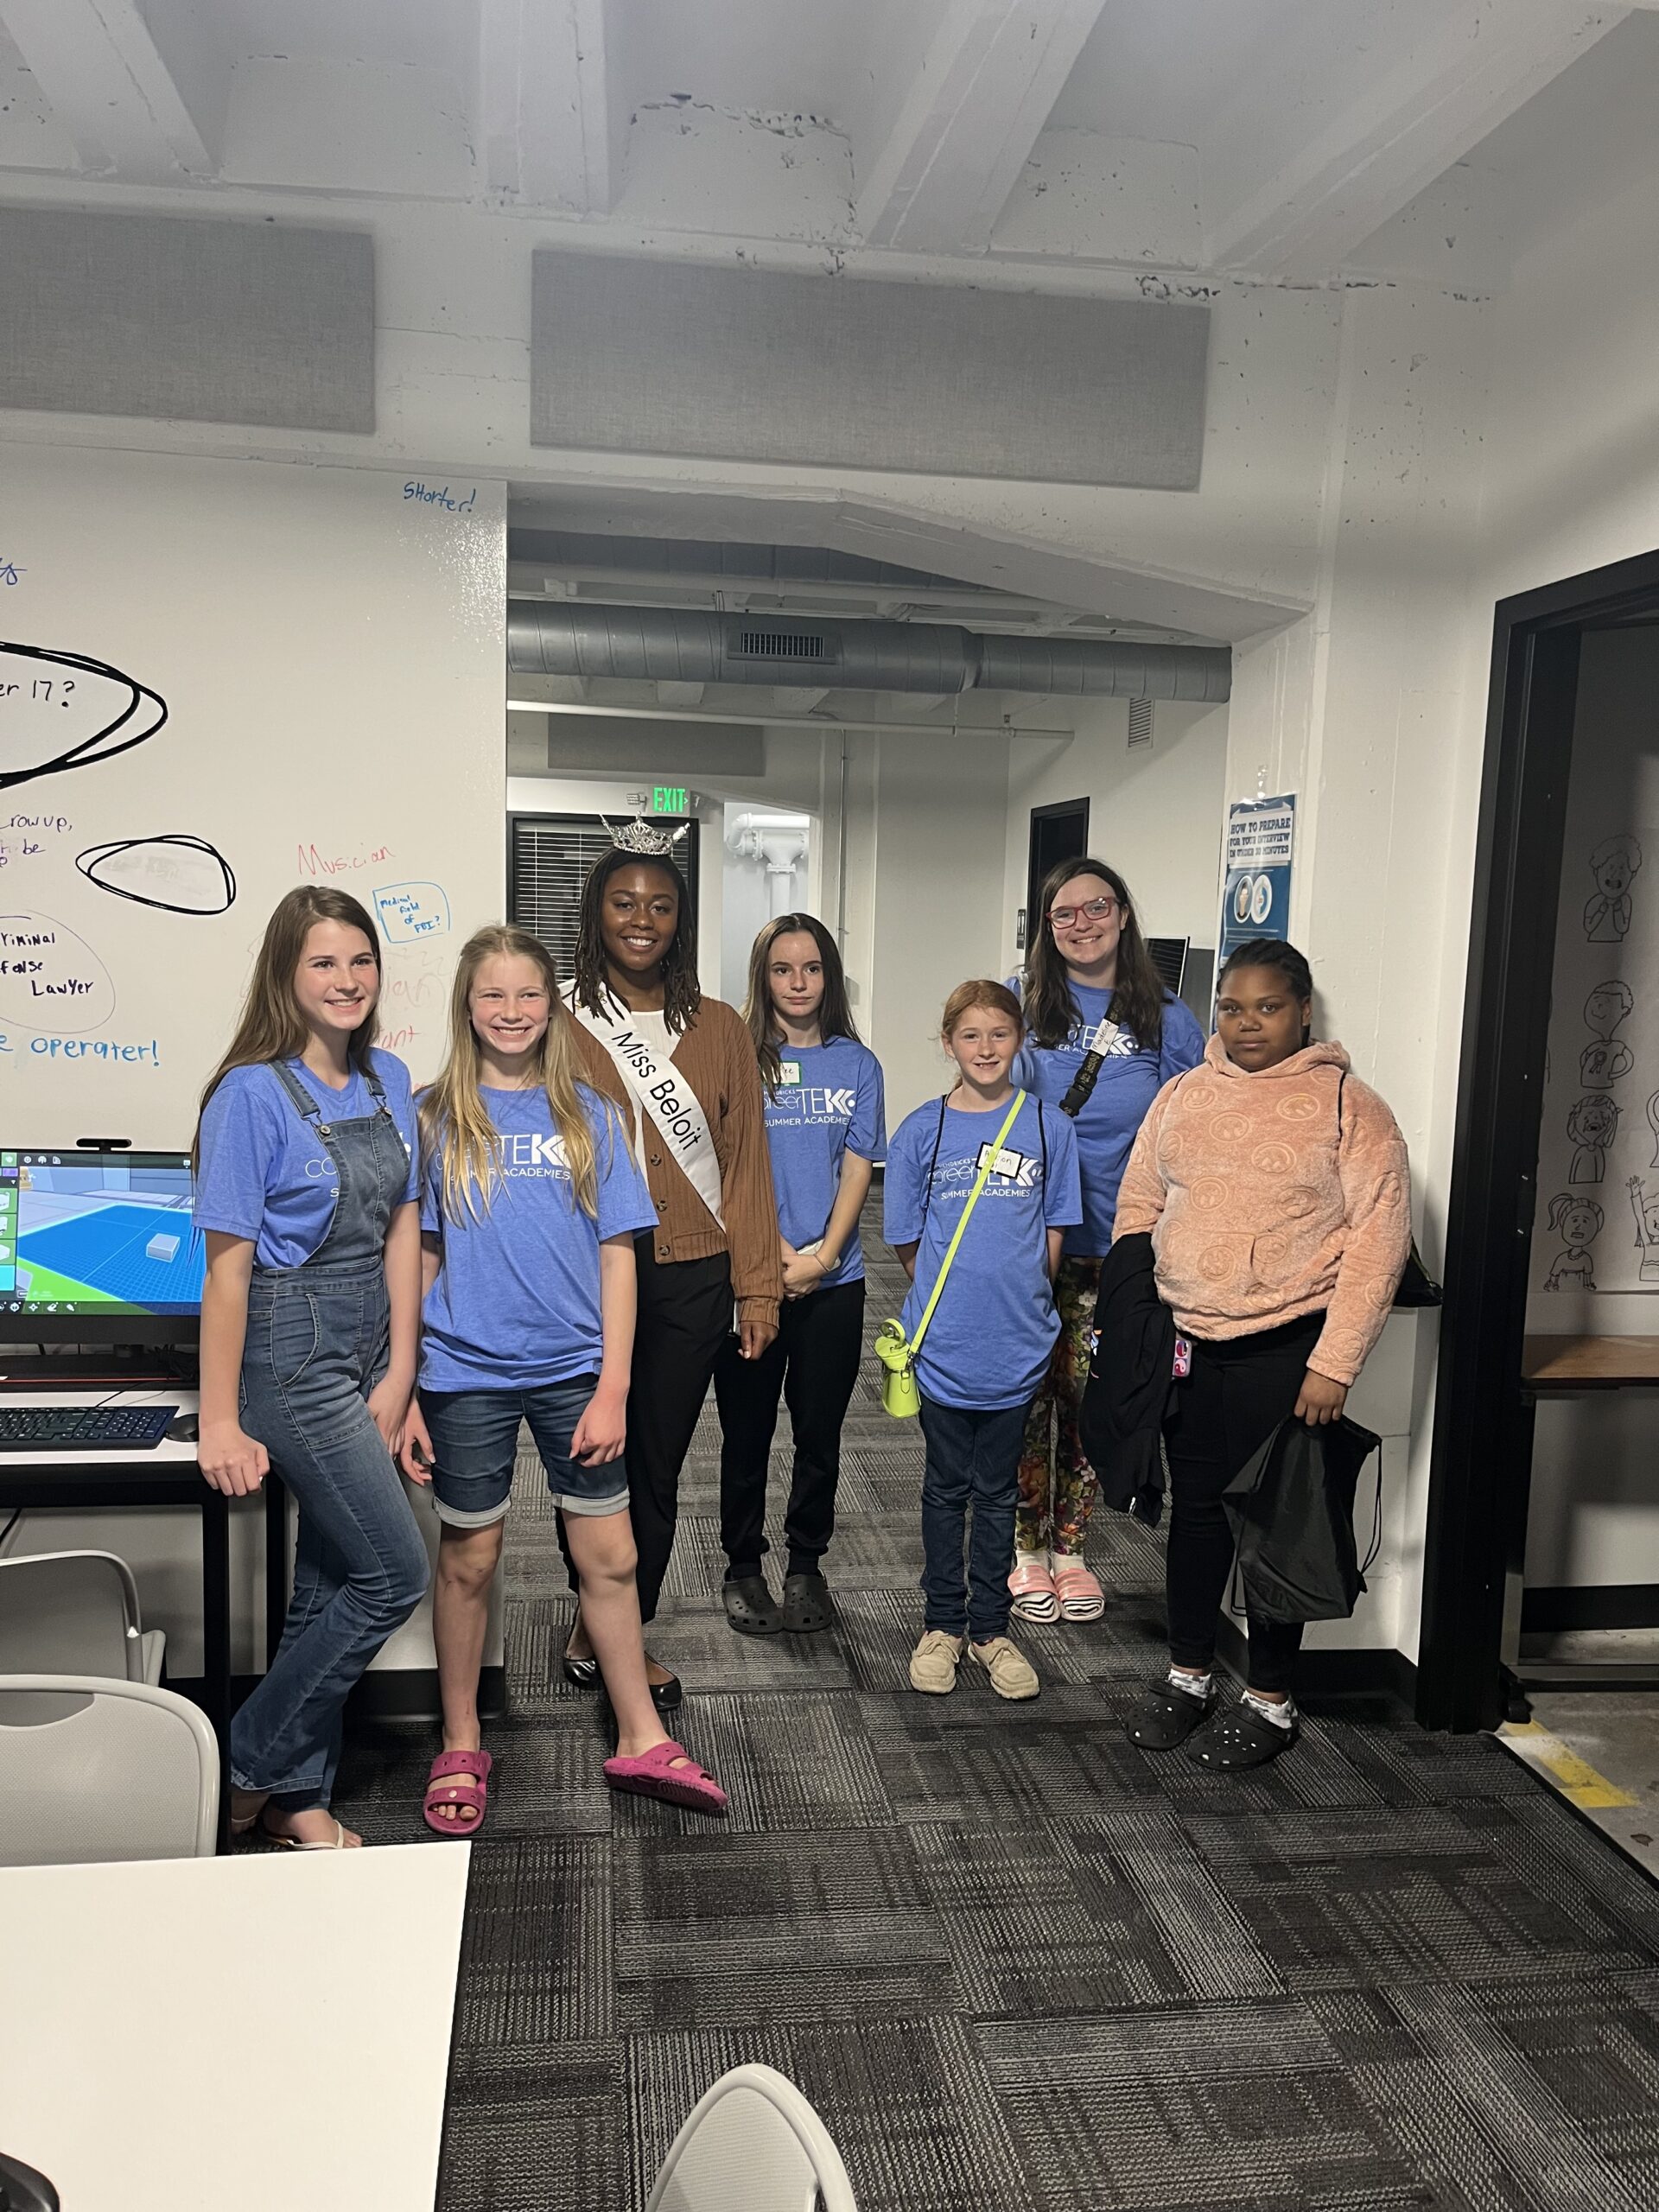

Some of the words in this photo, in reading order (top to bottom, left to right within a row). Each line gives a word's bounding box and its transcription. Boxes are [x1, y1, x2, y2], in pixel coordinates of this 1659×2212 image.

[653, 787, 685, 812] EXIT
[1230, 823, 1246, 835] HOW
[1249, 822, 1257, 833] TO
[1259, 817, 1291, 831] PREPARE
[1230, 837, 1240, 846] FOR
[1257, 832, 1290, 844] INTERVIEW
[1262, 845, 1289, 855] MINUTES
[611, 1032, 657, 1078] Miss
[650, 1078, 702, 1151] Beloit
[765, 1118, 801, 1128] SUMMER
[503, 1166, 571, 1180] ACADEMIES
[980, 1188, 1031, 1198] ACADEMIES
